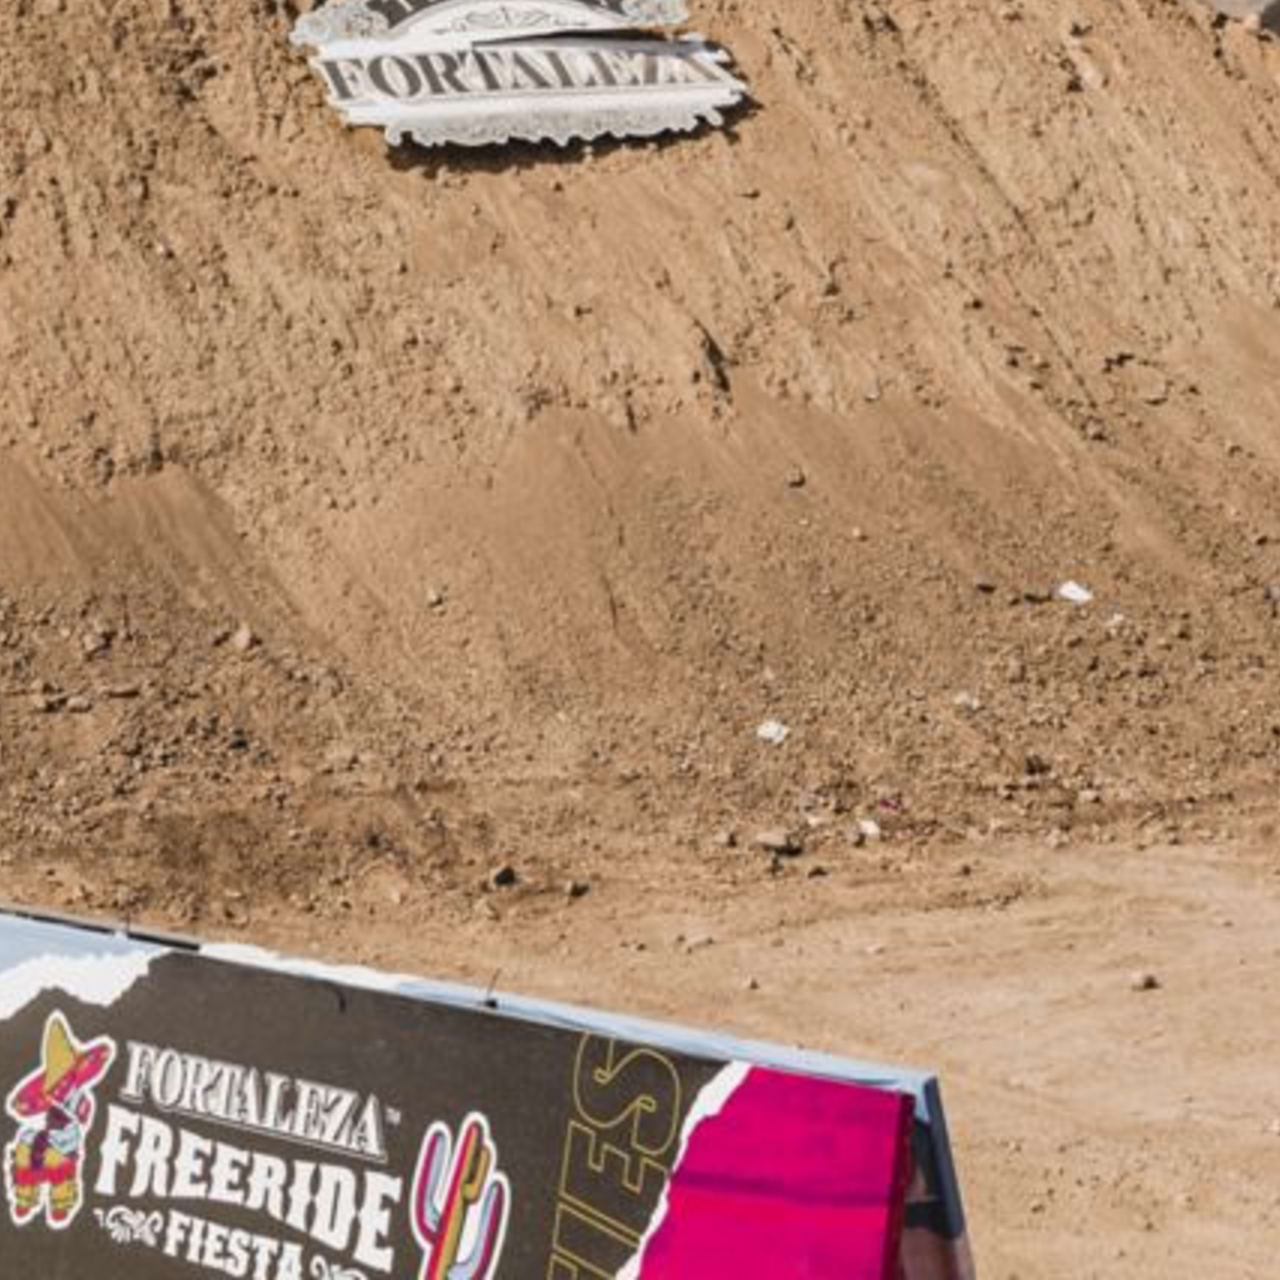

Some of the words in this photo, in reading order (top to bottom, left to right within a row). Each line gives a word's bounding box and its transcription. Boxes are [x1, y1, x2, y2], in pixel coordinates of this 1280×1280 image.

[120, 1041, 387, 1160] FORTALEZA
[94, 1103, 403, 1273] FREERIDE
[163, 1207, 303, 1280] FIESTA
